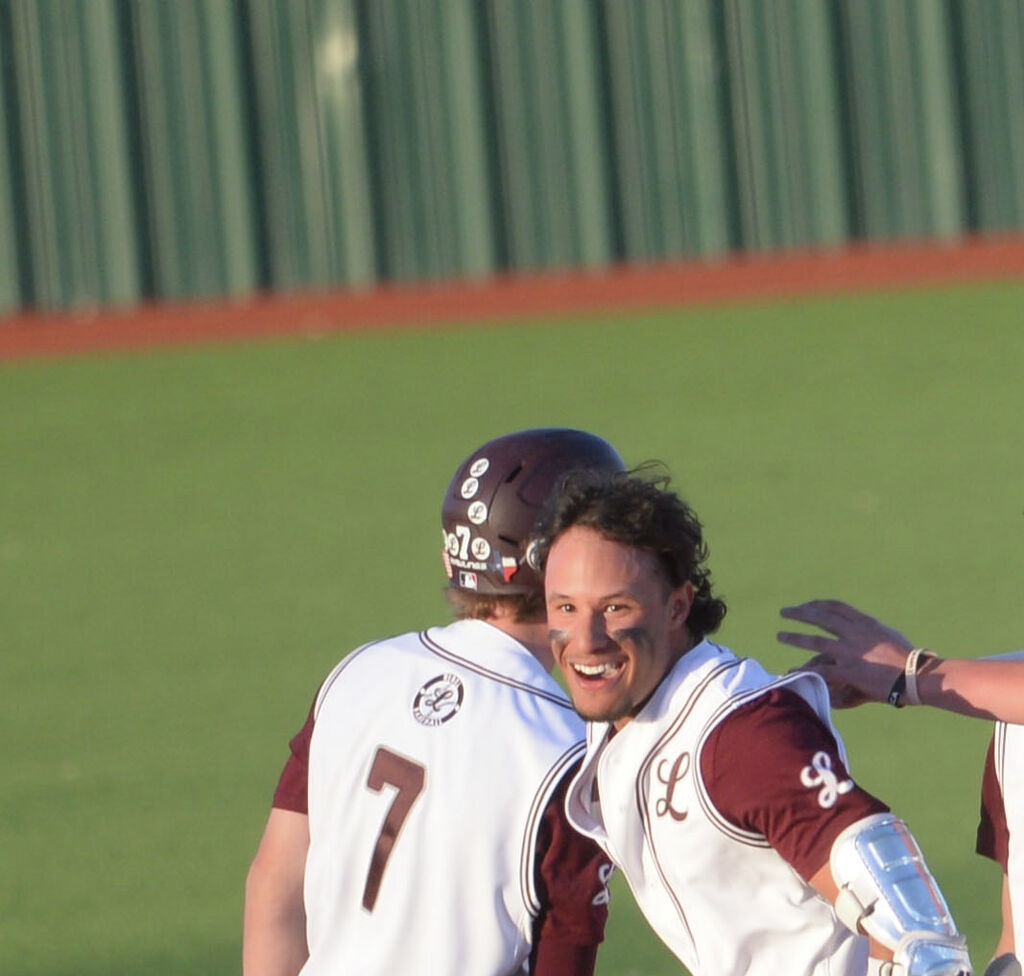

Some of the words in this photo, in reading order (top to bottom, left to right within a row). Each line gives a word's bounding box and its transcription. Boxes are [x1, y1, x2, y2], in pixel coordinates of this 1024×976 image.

[456, 525, 471, 560] 7
[655, 751, 691, 823] L
[364, 745, 428, 915] 7
